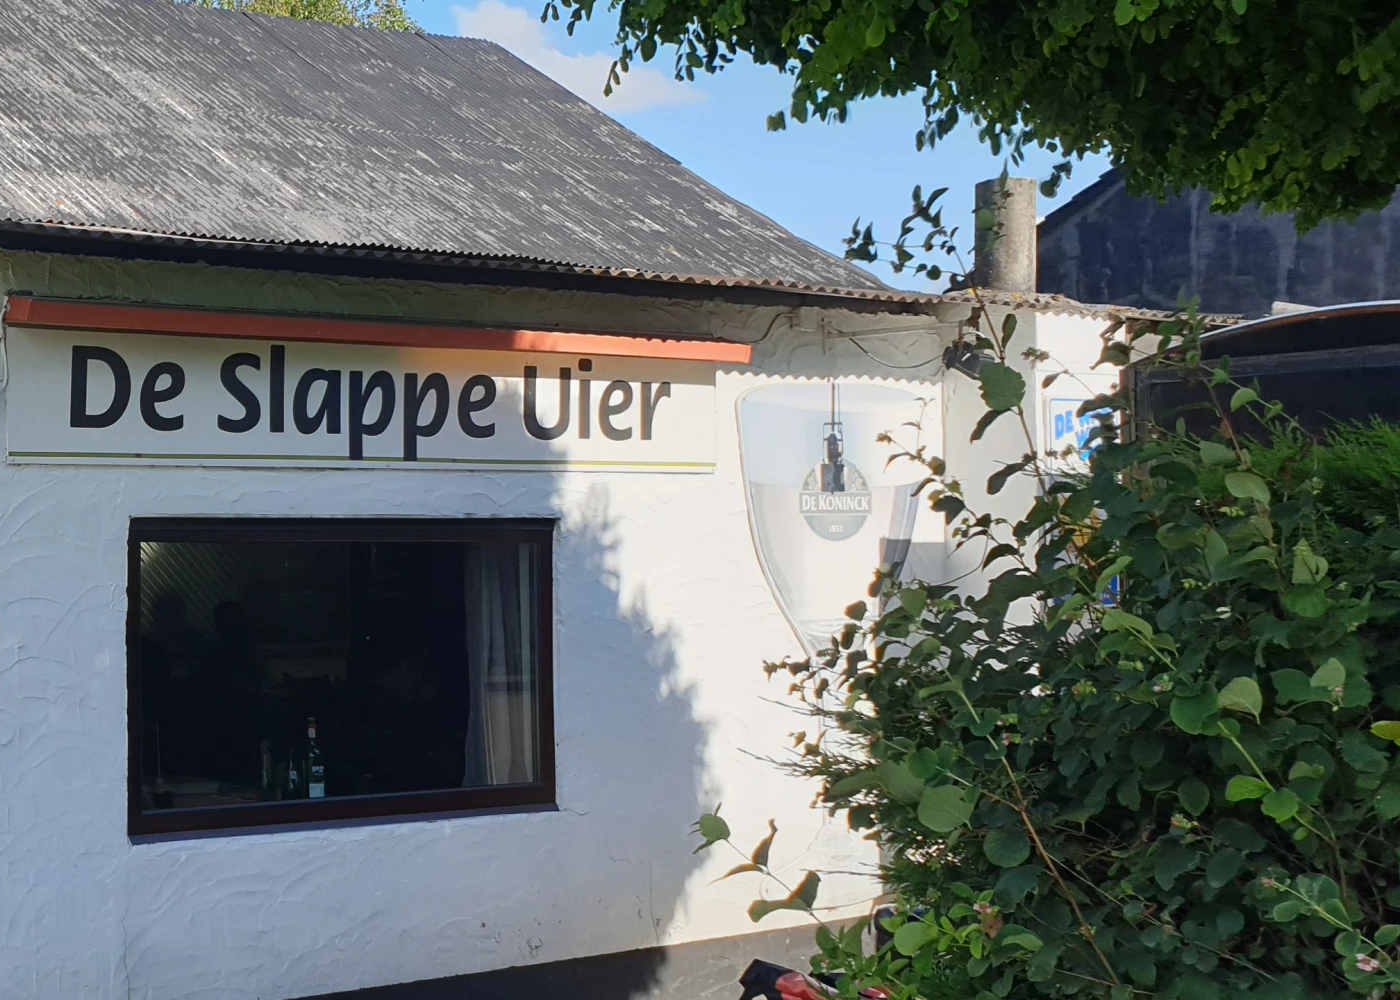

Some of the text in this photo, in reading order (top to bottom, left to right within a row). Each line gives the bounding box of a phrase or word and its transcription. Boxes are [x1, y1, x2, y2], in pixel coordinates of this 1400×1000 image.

[69, 344, 671, 461] De Slappe Uier
[1054, 410, 1075, 440] DE
[802, 494, 870, 511] DE KONINCK
[828, 524, 844, 533] 1833
